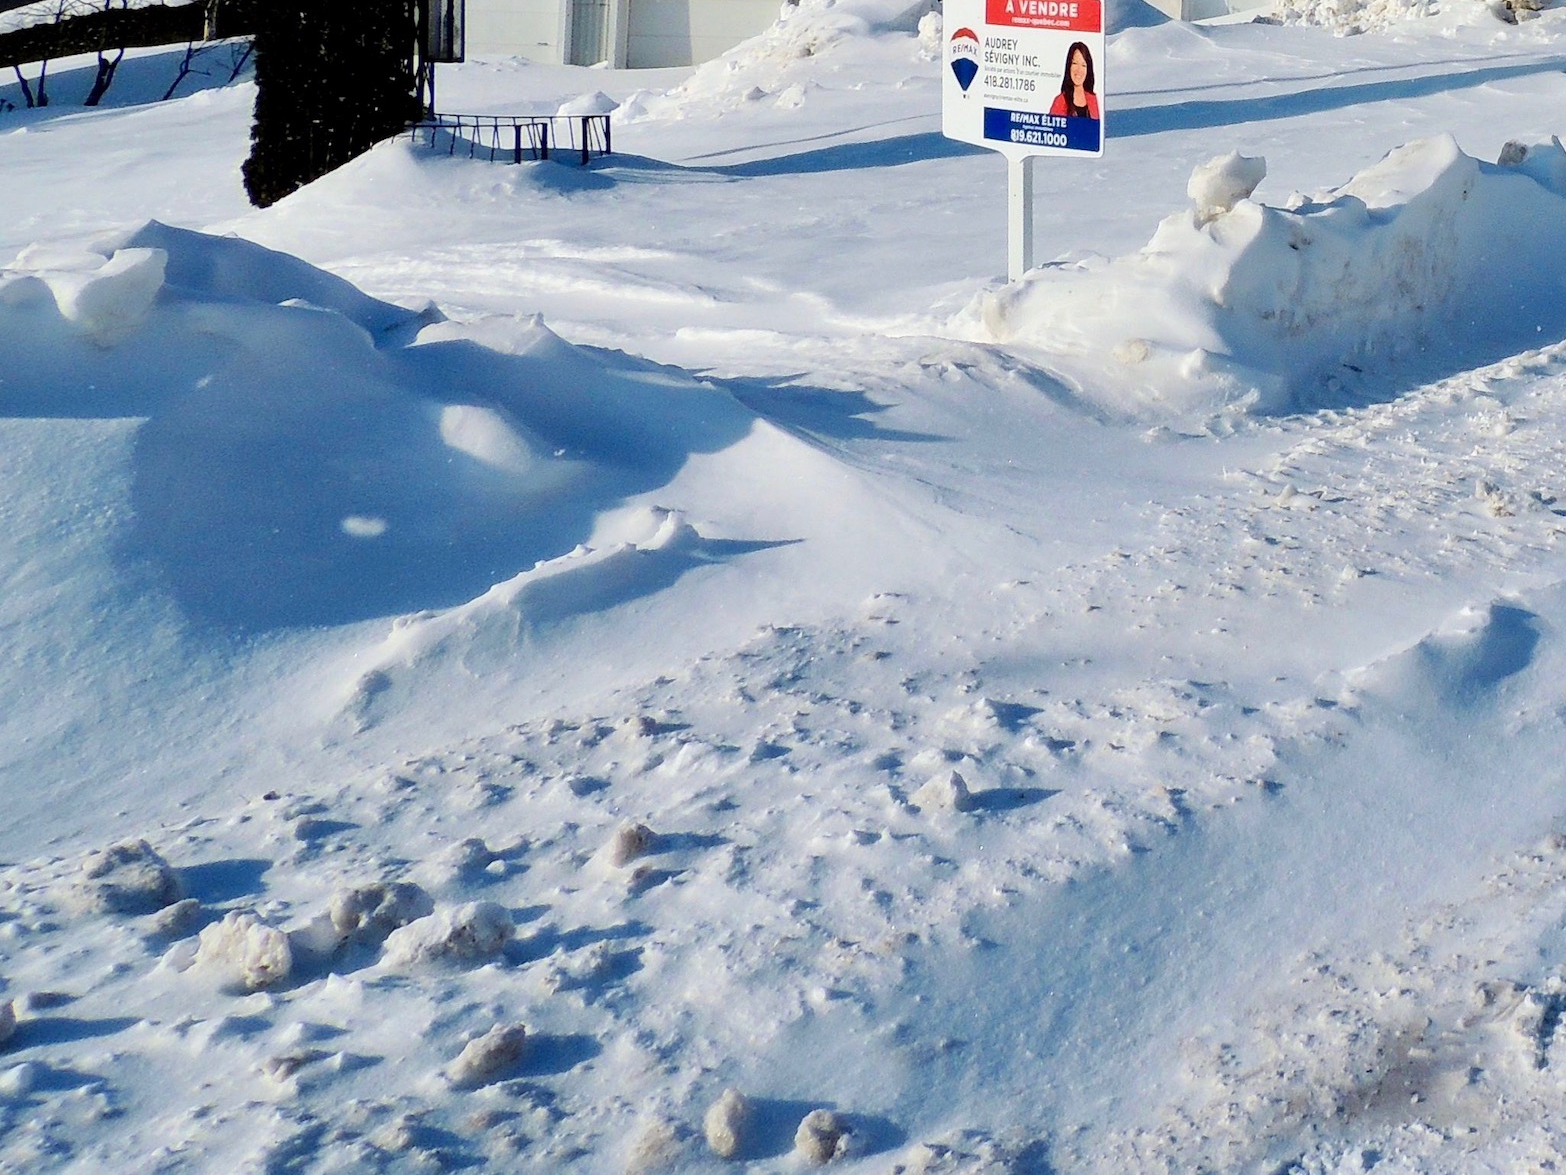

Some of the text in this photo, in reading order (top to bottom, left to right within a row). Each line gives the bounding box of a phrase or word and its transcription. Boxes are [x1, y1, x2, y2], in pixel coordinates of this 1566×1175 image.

[1019, 0, 1078, 17] VENDRE
[952, 44, 978, 57] RE/MAX
[985, 37, 1019, 50] AUDREY
[984, 51, 1041, 68] SÉVIGNY INC.
[984, 75, 1036, 92] 418.281.1786
[1010, 112, 1067, 128] RE/MAX ÉLITE
[1010, 128, 1068, 147] 819.621.1000
